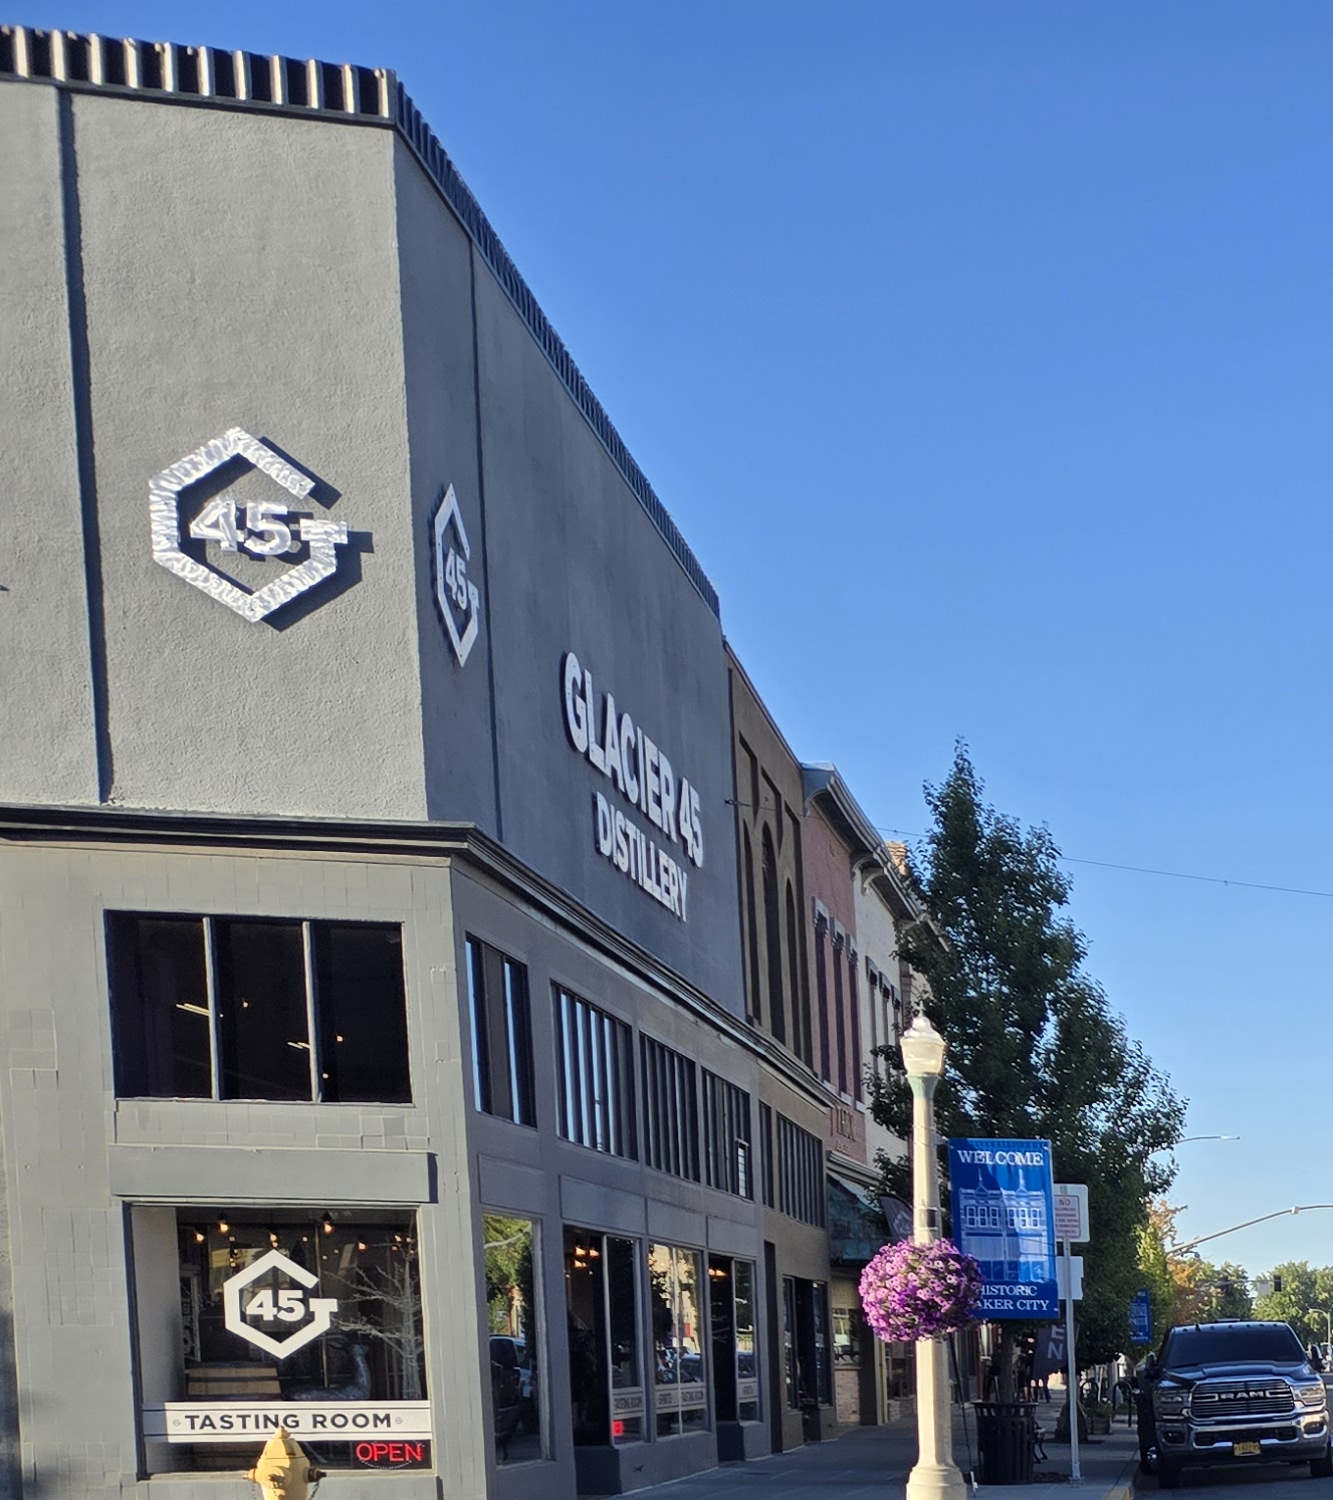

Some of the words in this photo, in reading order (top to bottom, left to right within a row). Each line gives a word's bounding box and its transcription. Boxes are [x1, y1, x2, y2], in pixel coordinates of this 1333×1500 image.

[190, 500, 293, 557] 45
[445, 549, 468, 610] 45
[562, 652, 677, 844] GLACIER
[678, 777, 705, 867] 45
[597, 792, 689, 922] DISTILLERY
[957, 1150, 1044, 1166] WELCOME
[1059, 1198, 1071, 1206] NO
[246, 1290, 305, 1322] 45
[976, 1300, 1014, 1310] AKER
[1020, 1300, 1050, 1310] CITY
[1220, 1391, 1264, 1400] RAM
[185, 1413, 300, 1430] TASTING
[312, 1413, 391, 1428] ROOM
[356, 1442, 424, 1462] OPEN
